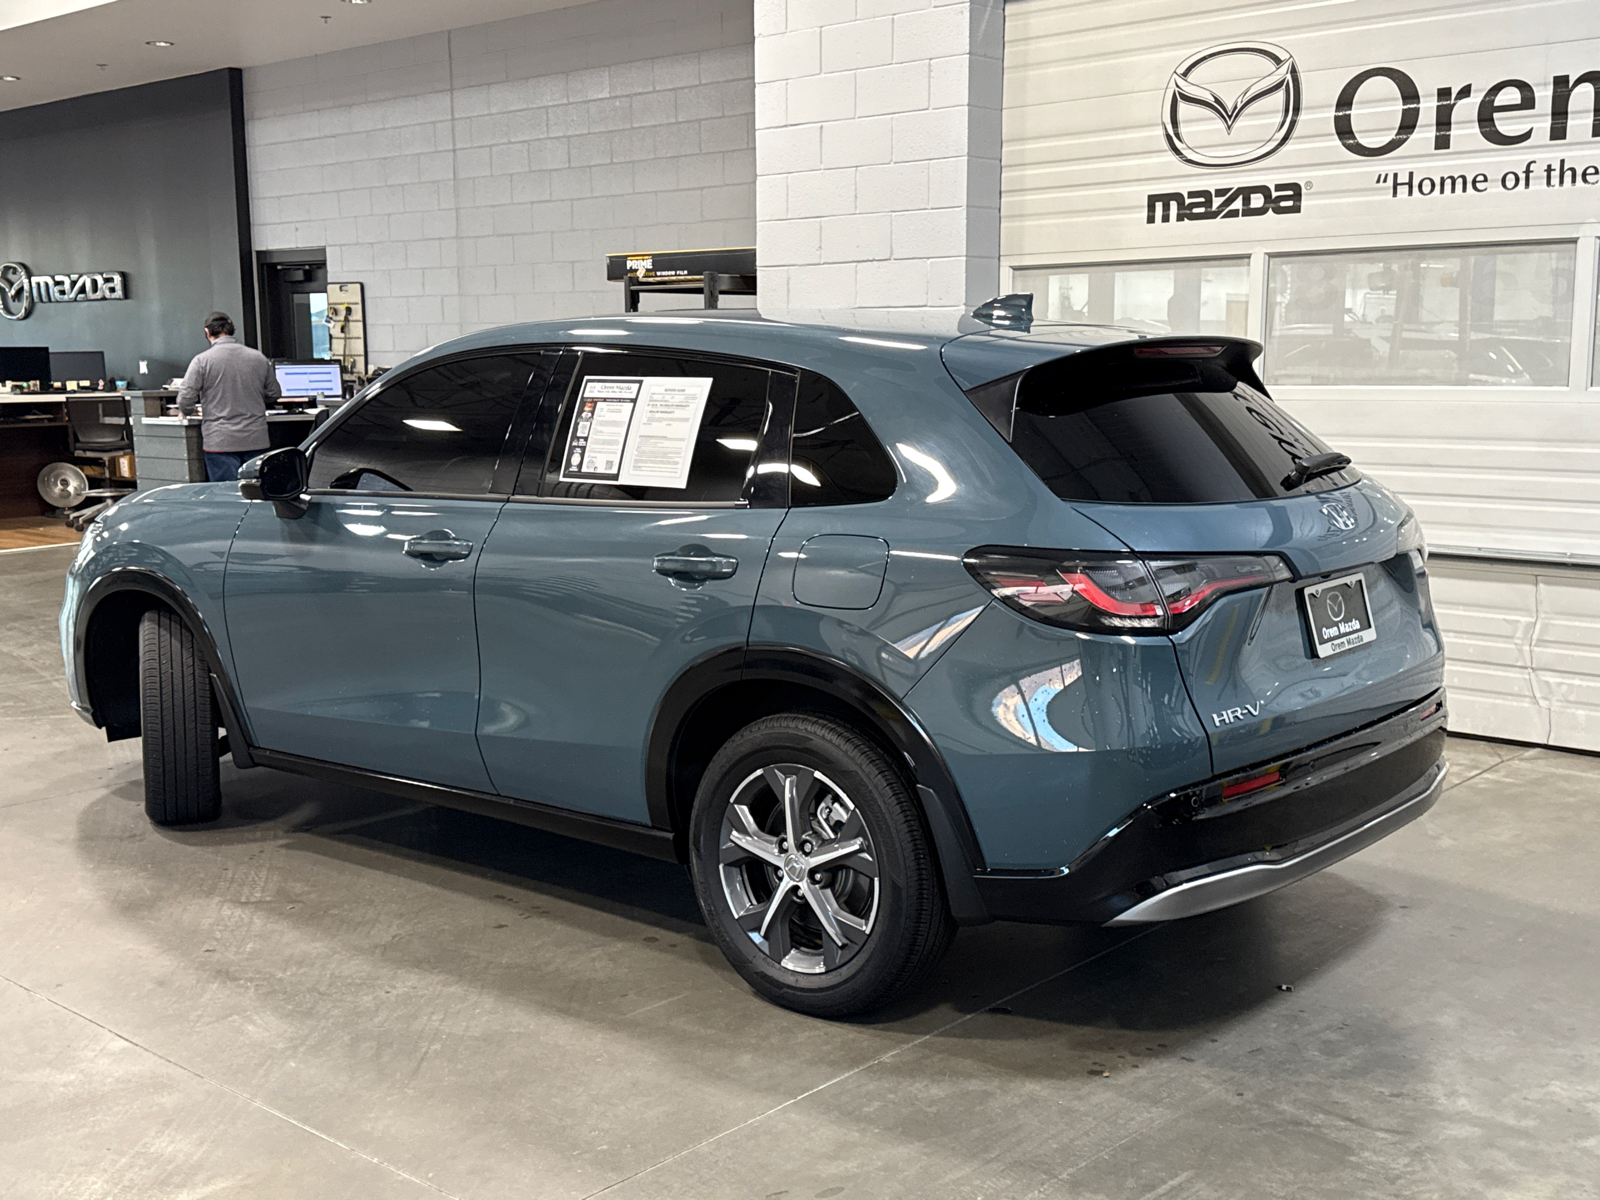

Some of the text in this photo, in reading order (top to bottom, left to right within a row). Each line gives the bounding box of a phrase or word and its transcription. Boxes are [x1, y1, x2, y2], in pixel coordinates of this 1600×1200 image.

[1501, 160, 1537, 191] of
[1544, 158, 1600, 187] the
[626, 259, 653, 270] PRIME
[1322, 618, 1361, 639] Orem Mazda
[1331, 634, 1364, 652] Orem Mazda
[1211, 700, 1260, 727] HR-V
